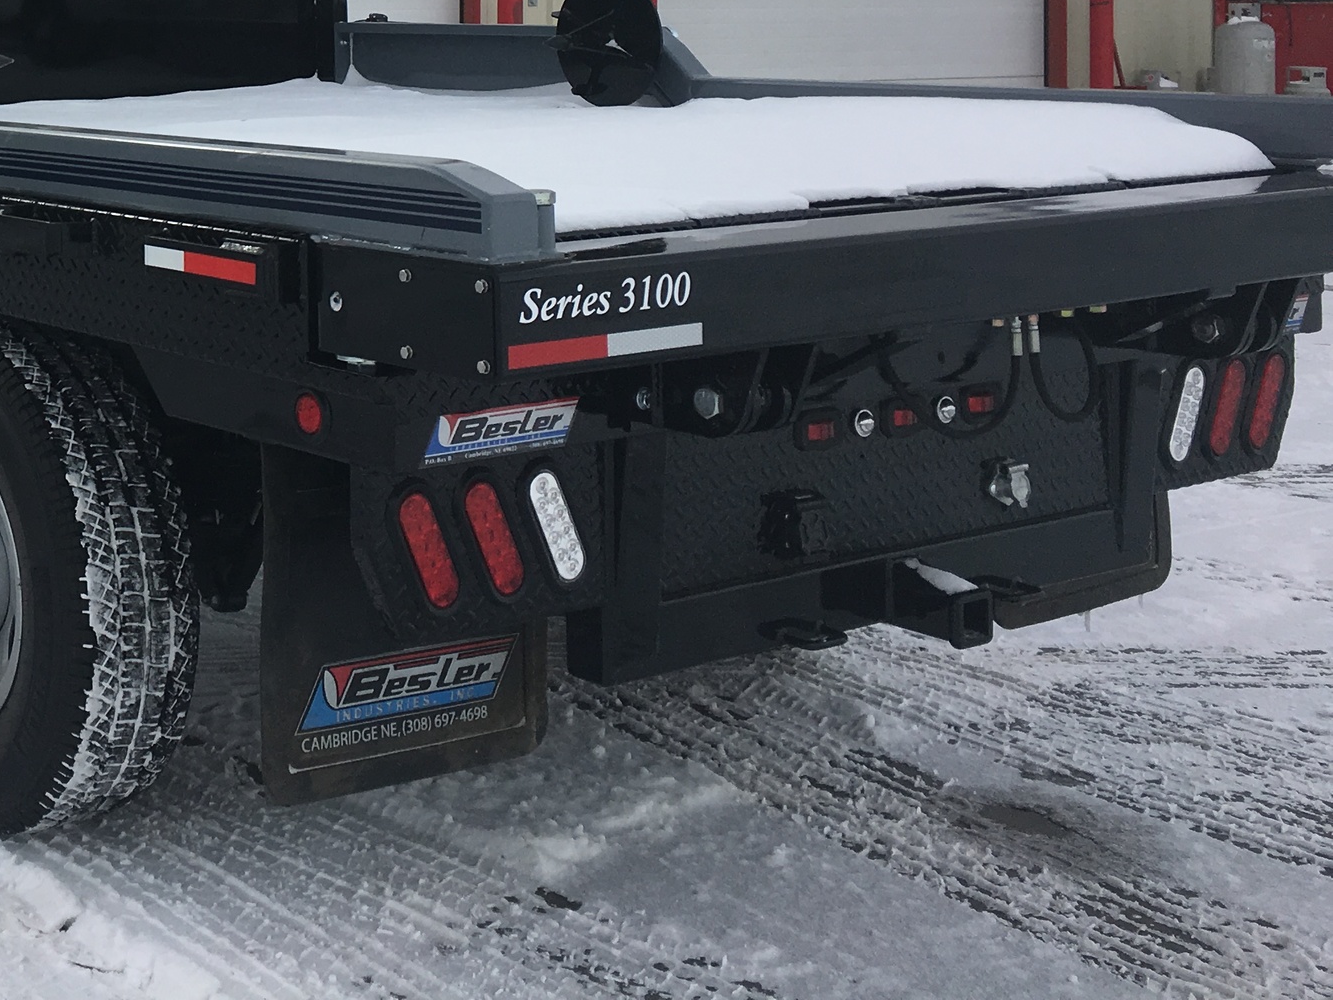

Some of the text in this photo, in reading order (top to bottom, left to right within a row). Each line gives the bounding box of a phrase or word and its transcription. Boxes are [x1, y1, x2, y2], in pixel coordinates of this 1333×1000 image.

[519, 271, 691, 324] Series 3100
[450, 409, 564, 445] Besler
[342, 657, 492, 705] Besler
[301, 705, 487, 753] CAMBRIDGE NE, (308) 697-4698
